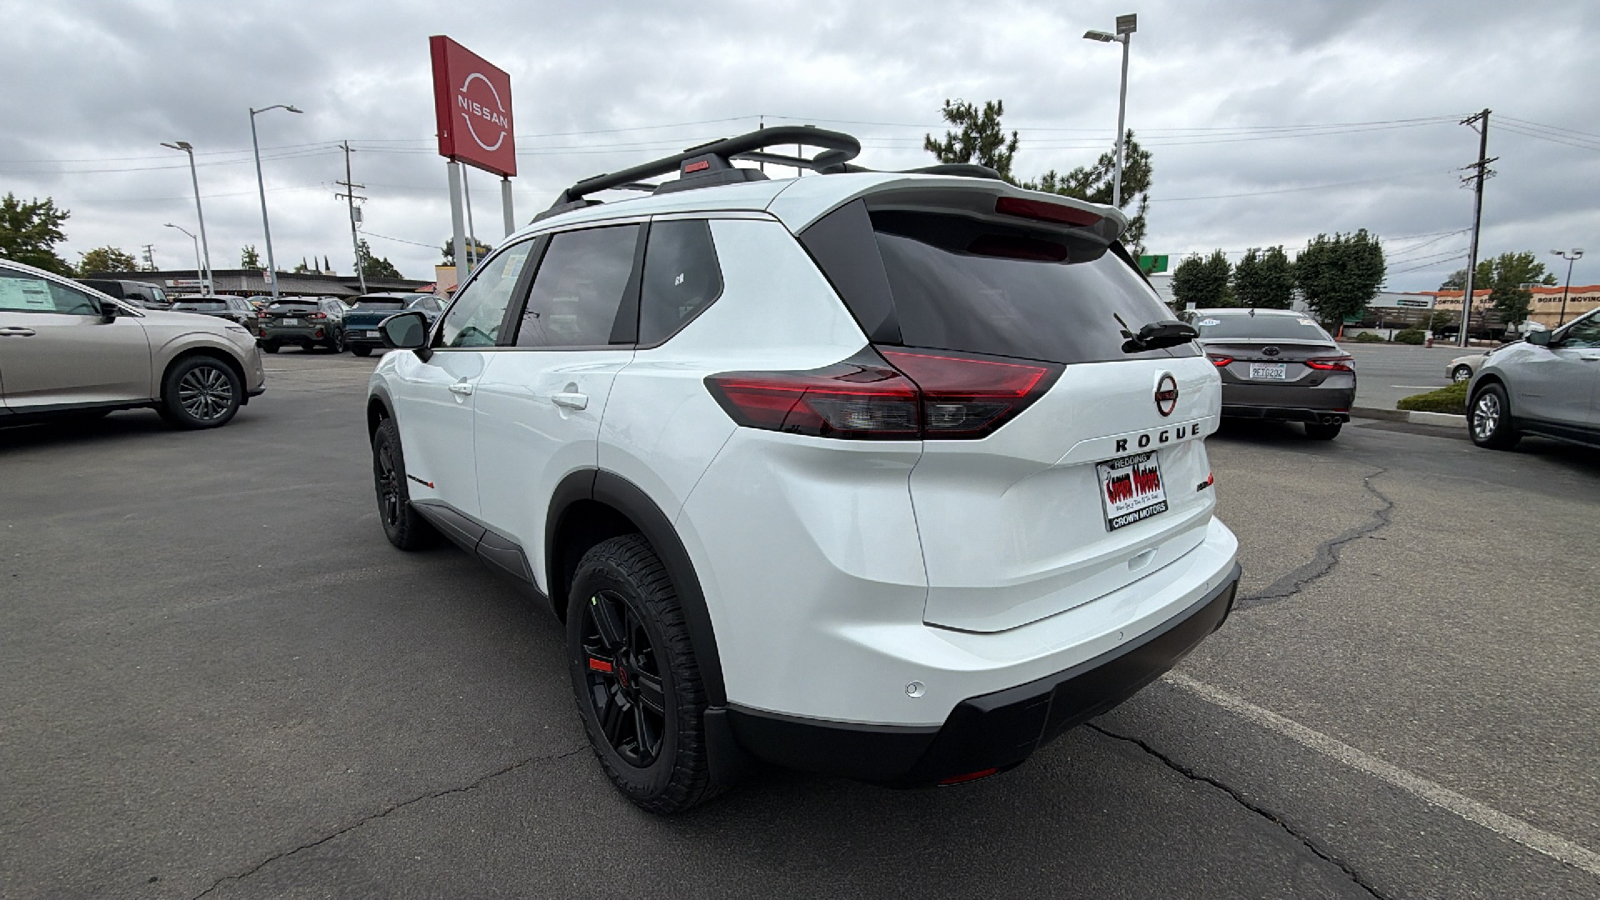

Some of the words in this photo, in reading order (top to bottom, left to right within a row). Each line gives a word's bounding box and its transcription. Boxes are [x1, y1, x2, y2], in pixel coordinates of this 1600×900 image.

[458, 94, 508, 129] NISSAN
[1115, 423, 1199, 453] ROGUE
[1114, 454, 1147, 469] REDDING
[1105, 471, 1133, 505] Crown
[1132, 463, 1160, 497] Motors
[1113, 512, 1139, 528] CROWN
[1140, 502, 1166, 518] MOTORS
